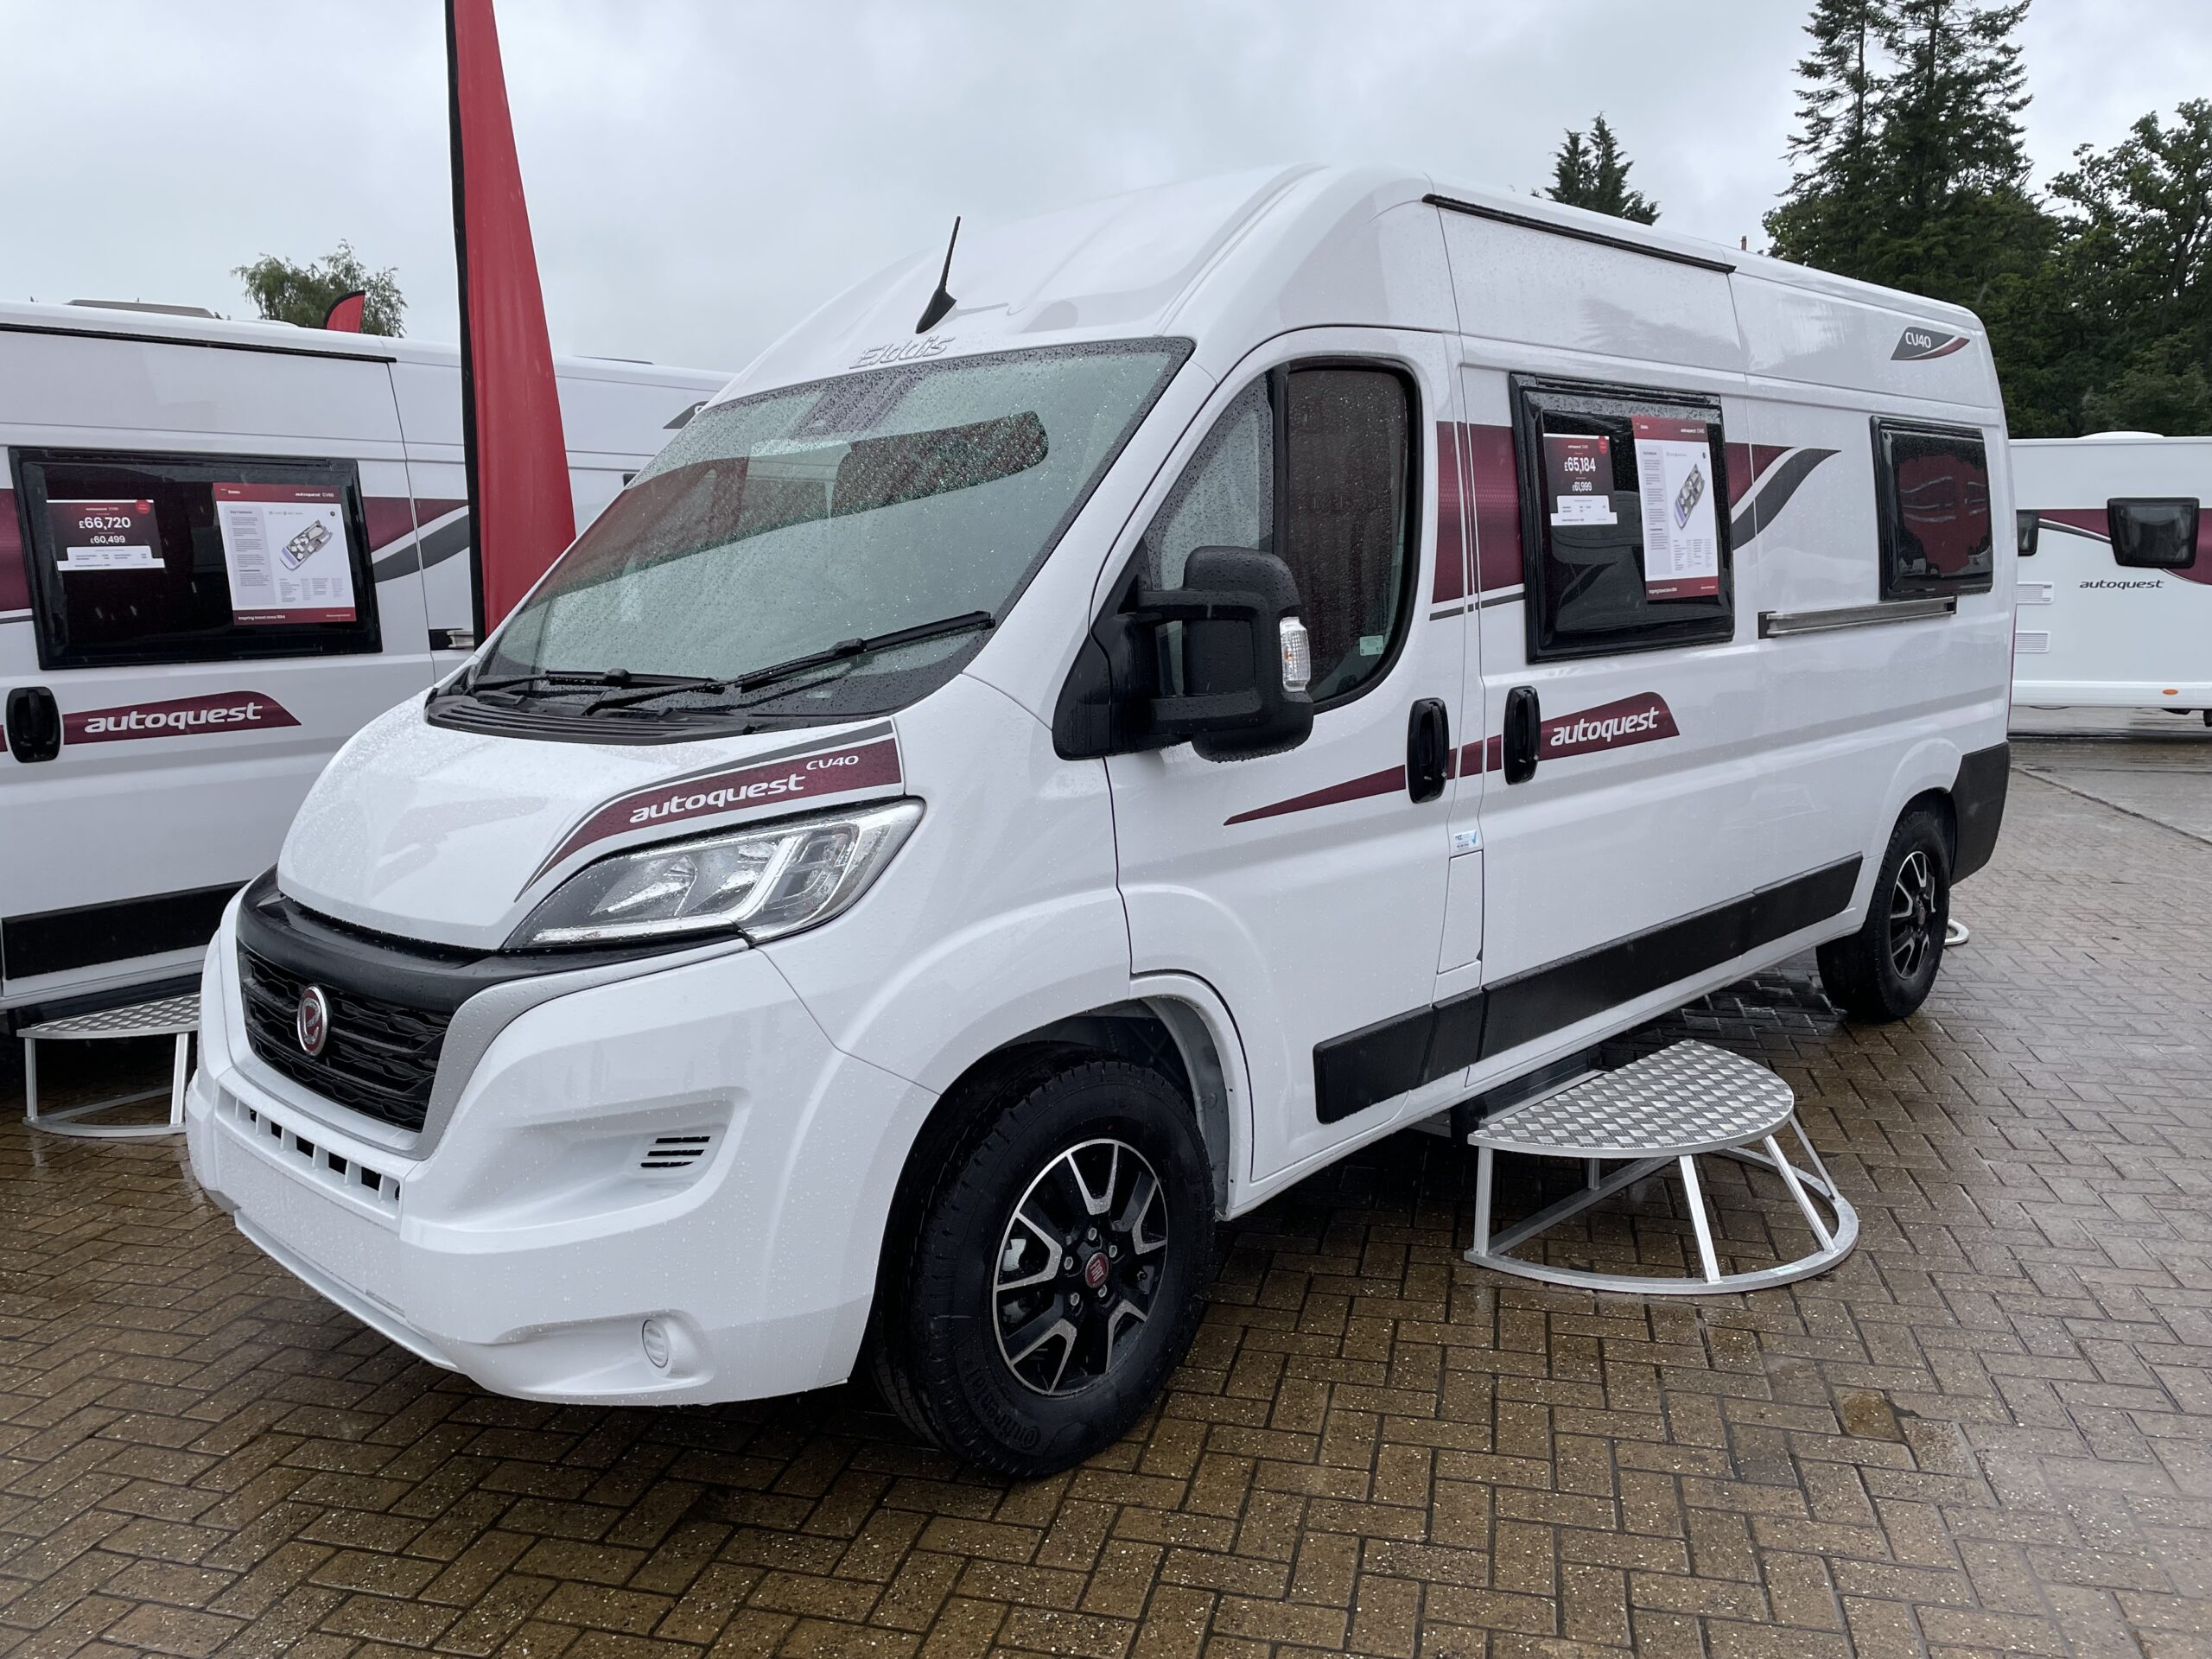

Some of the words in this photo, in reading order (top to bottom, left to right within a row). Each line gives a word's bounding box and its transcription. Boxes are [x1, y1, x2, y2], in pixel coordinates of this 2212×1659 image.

[1564, 456, 1596, 474] £65,184
[79, 517, 131, 531] £66,720
[90, 535, 125, 544] £60,499
[2079, 580, 2164, 590] autoquest
[85, 702, 263, 734] autoquest
[1550, 706, 1659, 747] autoquest
[629, 773, 805, 823] autoquest
[1090, 1258, 1104, 1282] FIAT
